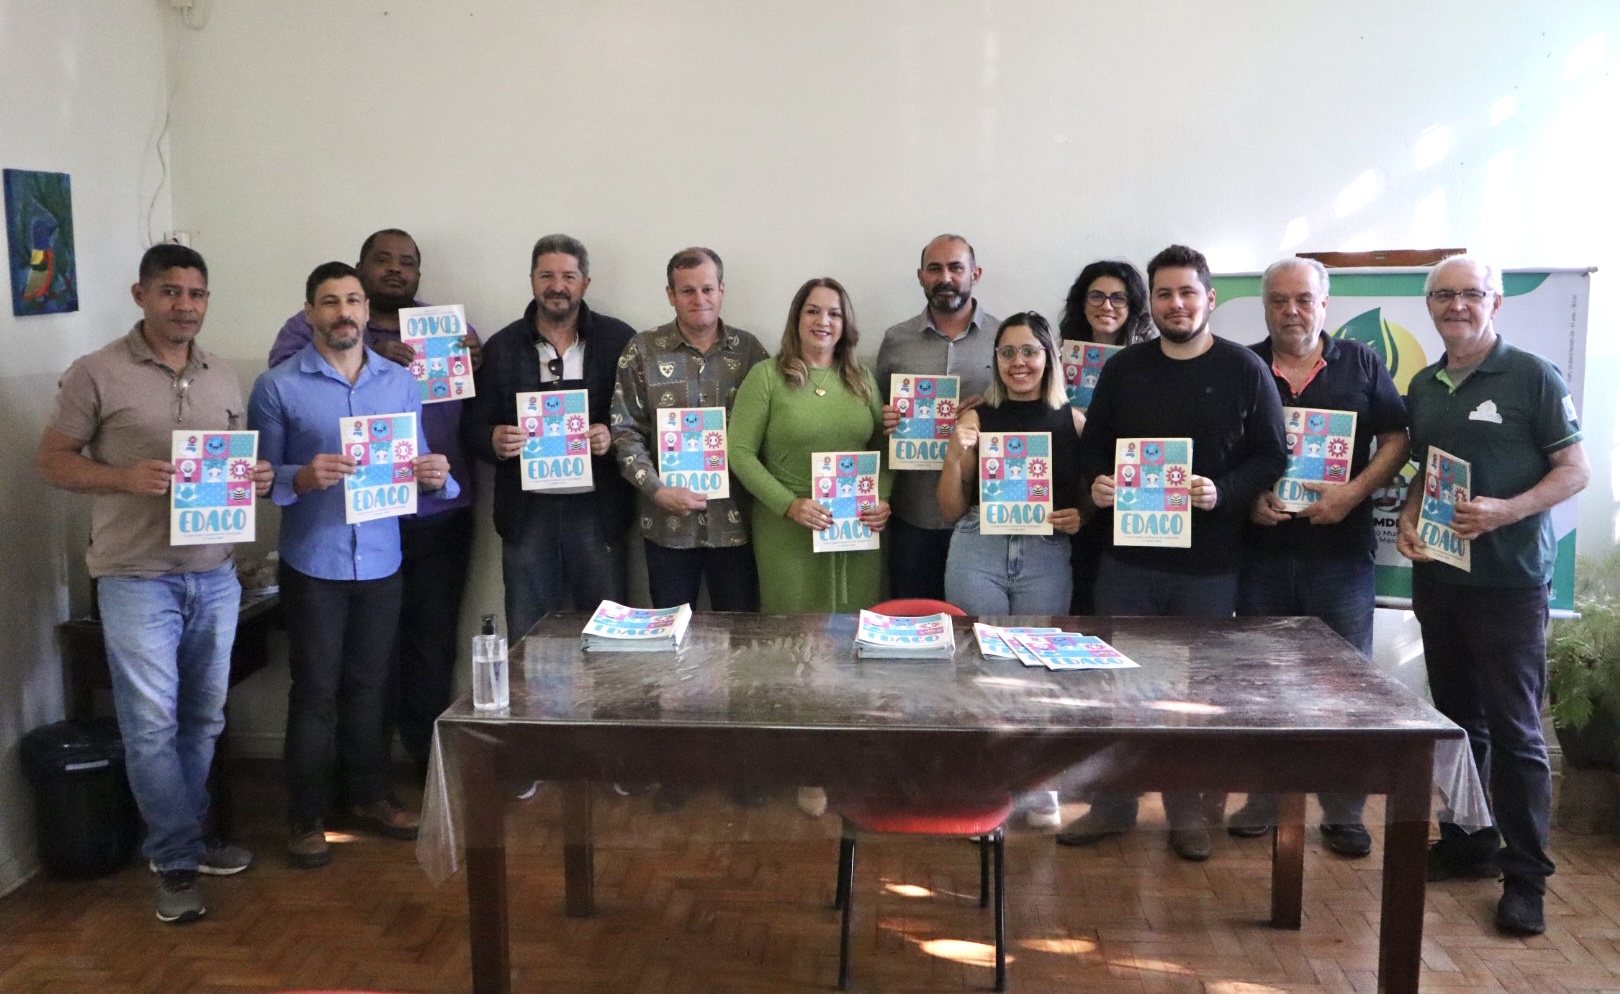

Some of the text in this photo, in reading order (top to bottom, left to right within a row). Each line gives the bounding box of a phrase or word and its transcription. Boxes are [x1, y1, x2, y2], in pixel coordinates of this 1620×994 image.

[407, 315, 460, 337] EDACO
[528, 457, 584, 479] EDACO
[353, 485, 409, 512] EDACO
[179, 508, 247, 533] EDACO
[987, 504, 1046, 524] EDACO
[1121, 513, 1184, 535] EDACO
